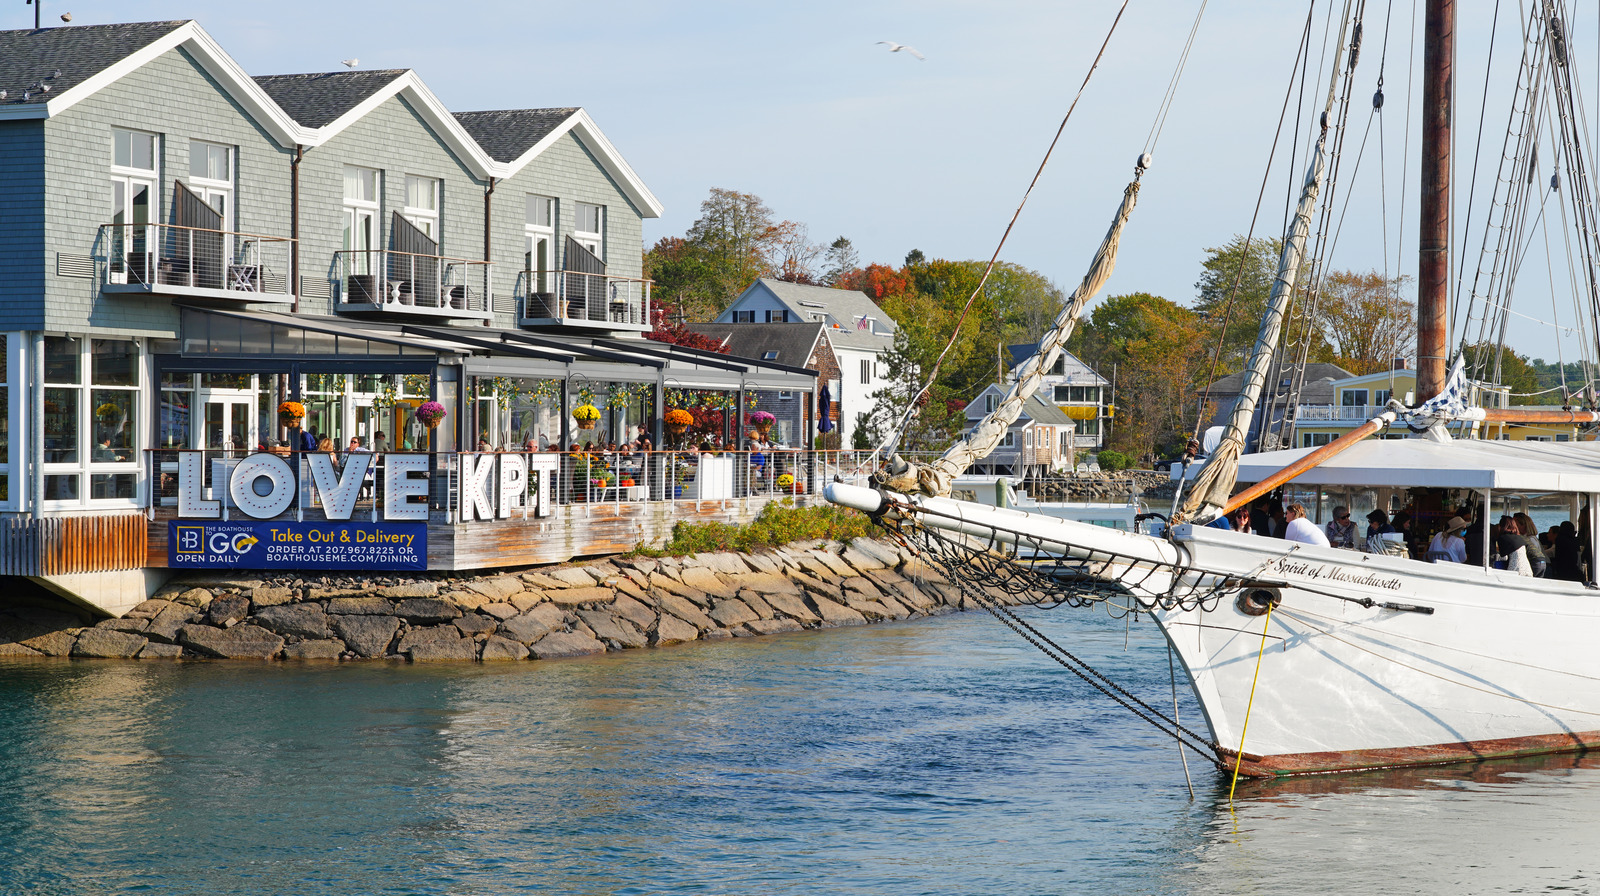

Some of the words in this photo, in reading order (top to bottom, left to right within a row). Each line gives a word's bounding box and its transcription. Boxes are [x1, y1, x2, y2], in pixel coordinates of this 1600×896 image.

[178, 451, 430, 520] LOVE
[461, 452, 557, 521] KPT
[209, 532, 253, 554] GO
[270, 528, 303, 542] Take
[308, 529, 335, 543] Out
[339, 529, 351, 543] &
[356, 529, 415, 547] Delivery
[176, 554, 205, 562] OPEN
[209, 555, 240, 563] DAILY
[266, 554, 418, 563] BOATHOUSEME.COM/DINING
[267, 545, 305, 554] ORDER
[308, 546, 322, 554] AT
[325, 546, 394, 554] 207.967.8225
[398, 546, 414, 554] OR
[1273, 558, 1309, 576] Spirit
[1308, 564, 1326, 579] of
[1323, 566, 1401, 590] Massachusetts
